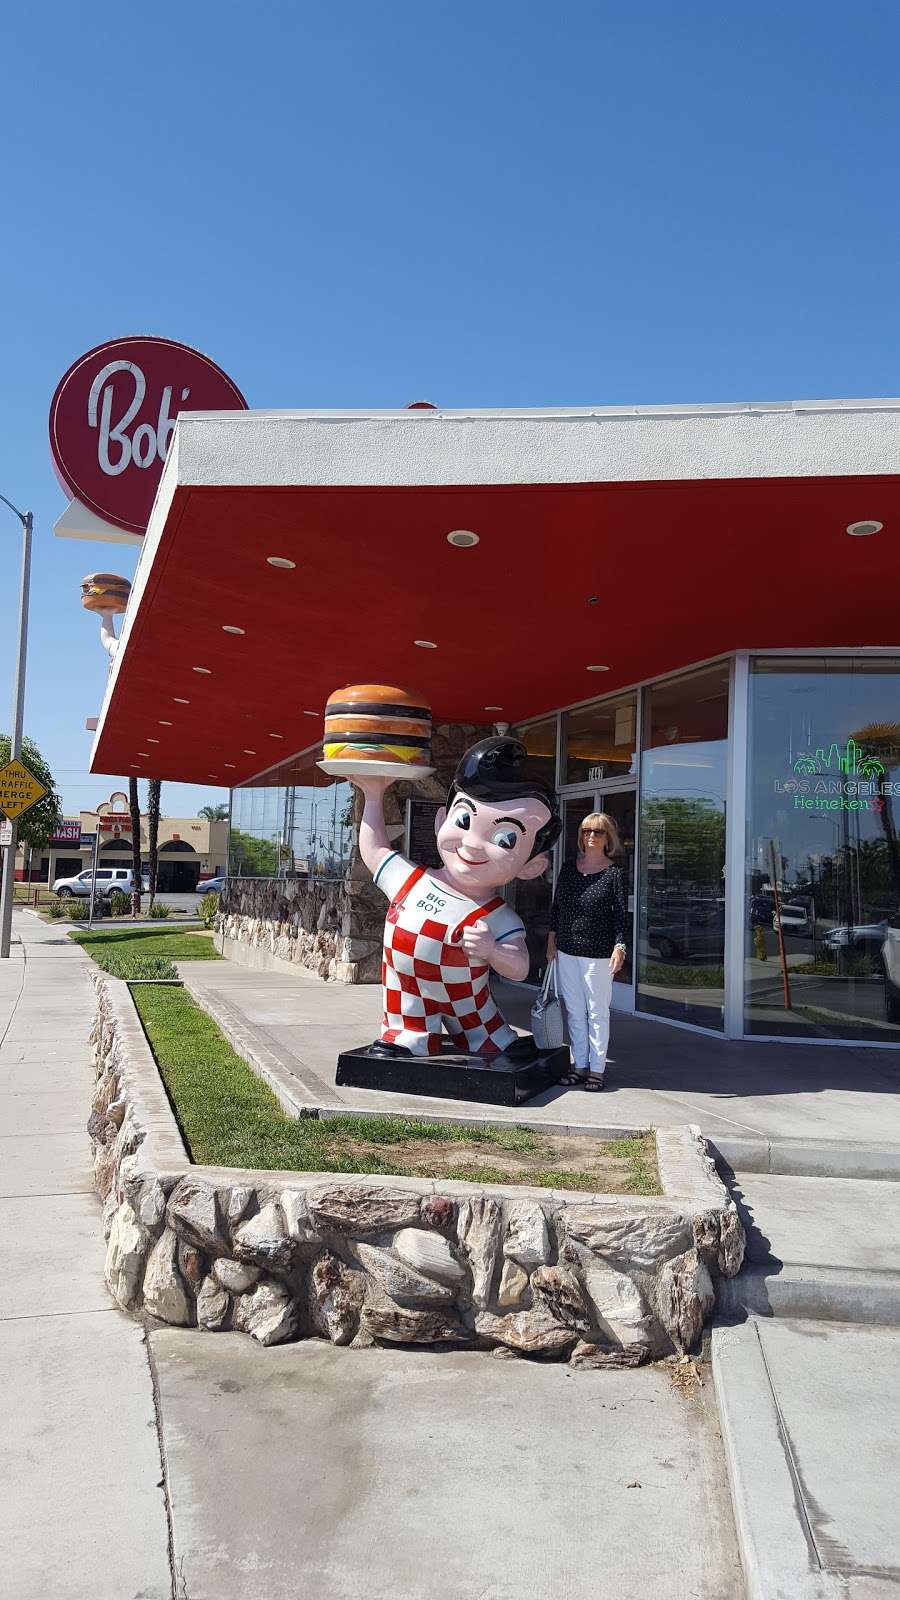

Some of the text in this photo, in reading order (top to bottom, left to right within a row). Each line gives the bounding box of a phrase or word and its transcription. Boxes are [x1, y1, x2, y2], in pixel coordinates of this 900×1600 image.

[88, 360, 190, 475] Bob'
[5, 769, 26, 779] THRU
[0, 781, 34, 789] RAFFIC
[774, 780, 811, 793] LOS
[0, 790, 33, 799] ERGE
[1, 801, 24, 809] LEFT
[793, 796, 870, 809] Heineken
[426, 893, 447, 907] BIG
[416, 900, 442, 915] BOY
